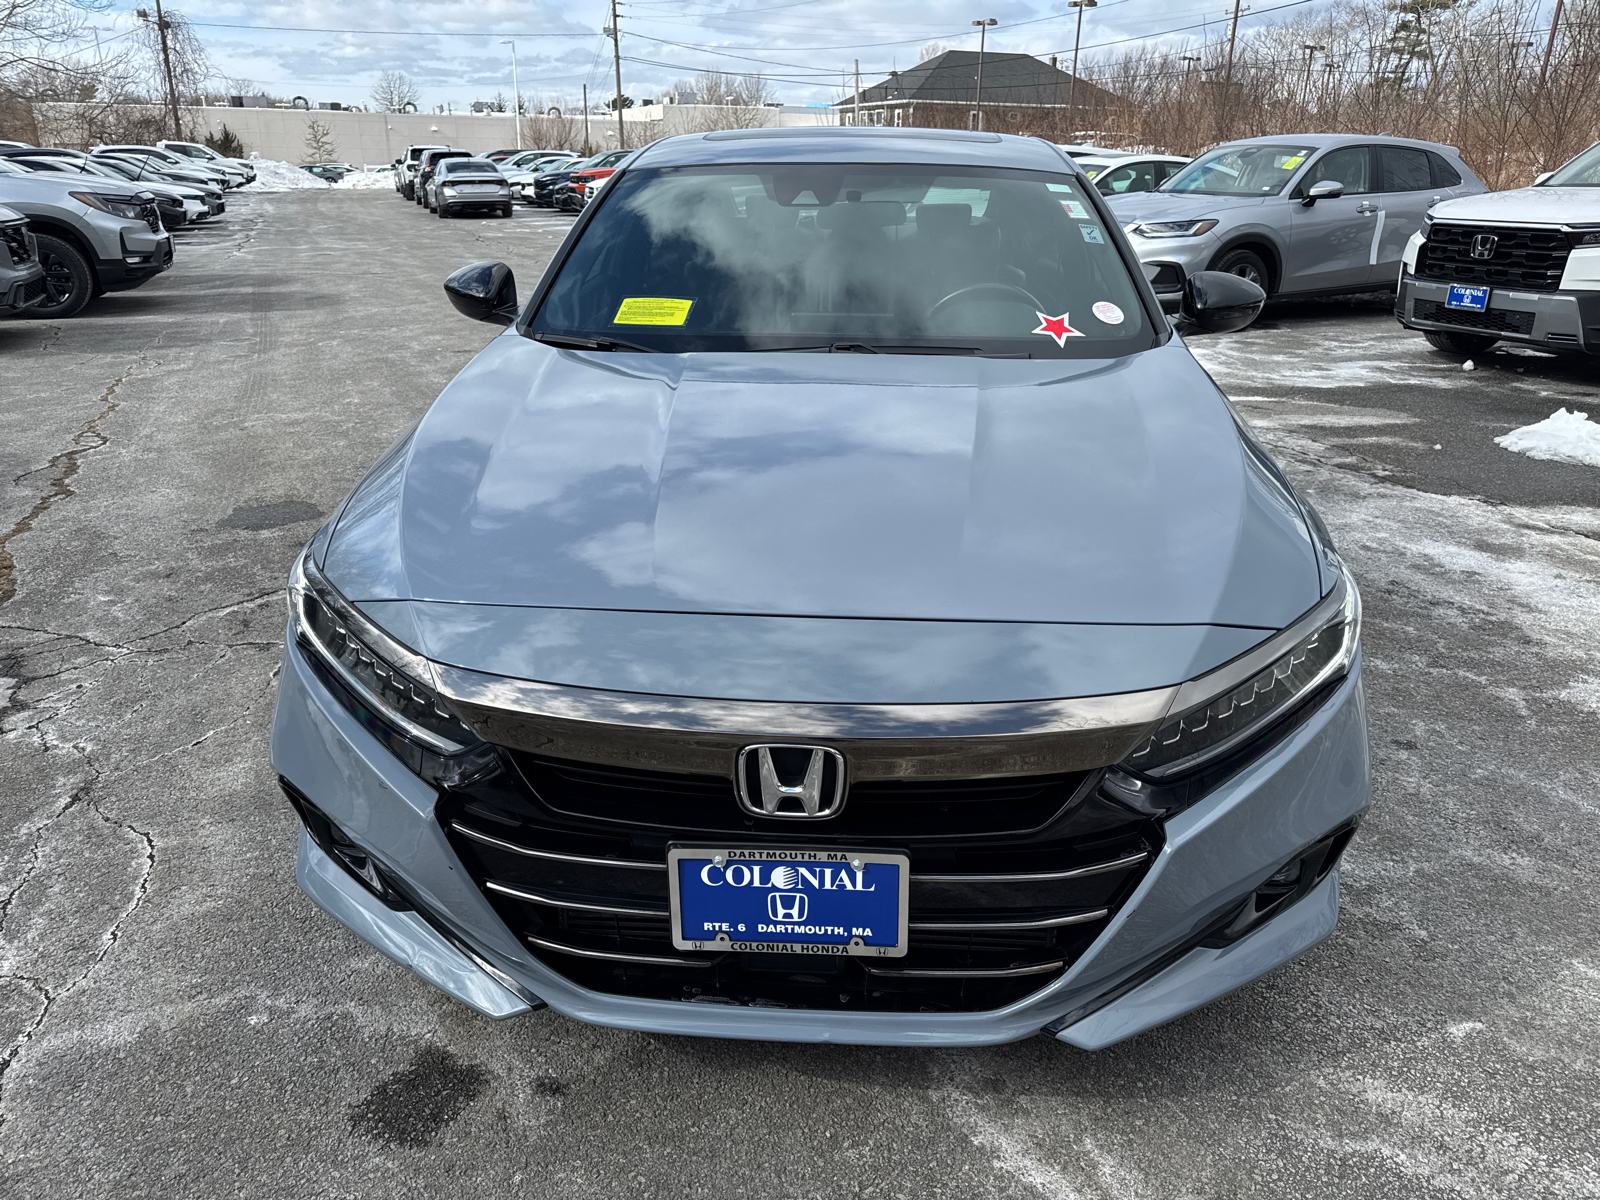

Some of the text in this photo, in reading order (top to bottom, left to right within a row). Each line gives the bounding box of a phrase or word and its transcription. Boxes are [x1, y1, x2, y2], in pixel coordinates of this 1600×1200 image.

[1454, 288, 1484, 296] COLONIAL
[728, 851, 848, 861] DARTMOUTH, MA
[701, 865, 875, 891] COLONIAL
[703, 922, 873, 937] RTE. 6 DARTMOUTH, MA
[731, 941, 850, 955] COLONIAL HONDA
